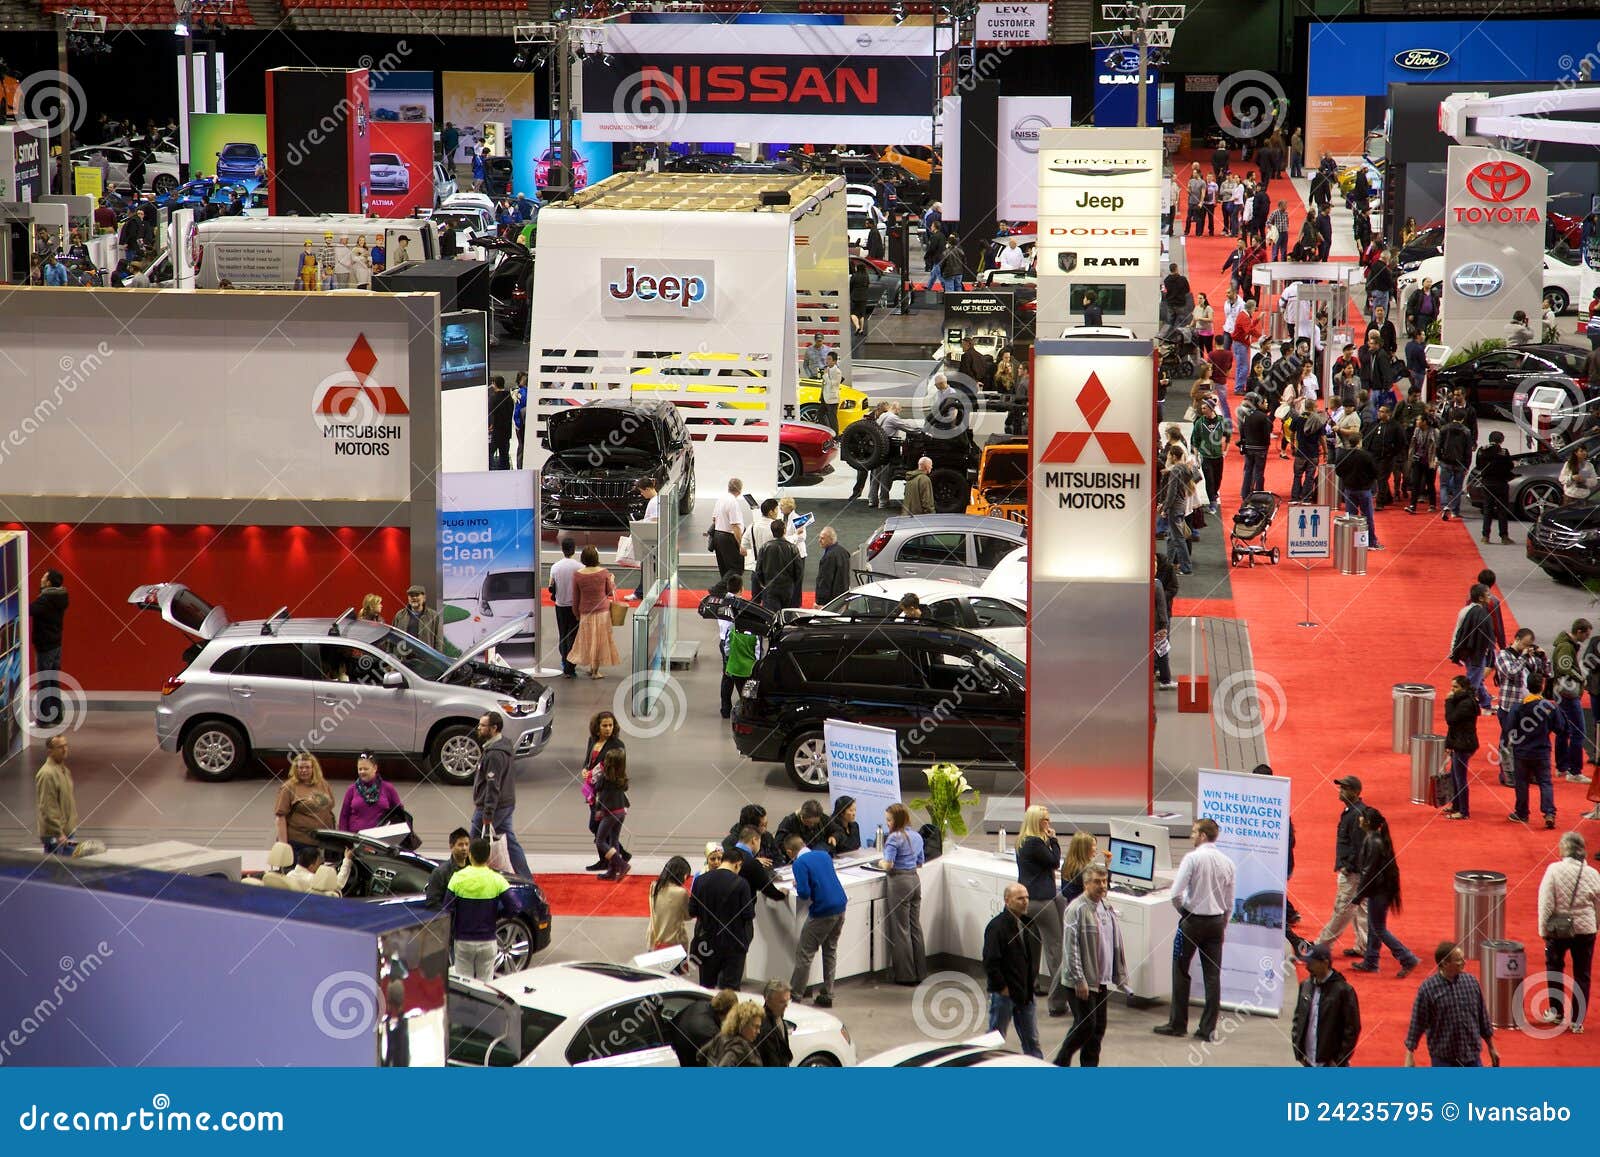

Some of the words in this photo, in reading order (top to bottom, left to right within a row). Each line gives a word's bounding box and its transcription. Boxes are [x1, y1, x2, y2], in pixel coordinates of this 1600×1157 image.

[992, 30, 1031, 38] SERVICE
[1404, 51, 1440, 66] Ford
[641, 66, 878, 104] NISSAN
[1076, 192, 1124, 211] Jeep
[1453, 207, 1541, 223] TOYOTA
[1083, 257, 1140, 267] RAM
[608, 266, 706, 308] Jeep
[323, 424, 401, 440] MITSUBISHI
[335, 442, 390, 456] MOTORS
[1045, 472, 1140, 489] MITSUBISHI
[1058, 493, 1126, 510] MOTORS
[441, 519, 464, 527] PLUG
[467, 518, 489, 527] INTO
[441, 527, 493, 545] Good
[1290, 540, 1328, 548] WASHROOMS
[442, 545, 495, 561] Clean
[442, 563, 476, 577] Fun
[831, 749, 893, 767] VOLKSWAGEN
[831, 761, 873, 773] INOUBLIABLE
[876, 767, 893, 777] POUR
[832, 770, 848, 778] DEUX
[858, 774, 893, 785] ALLEMAGNE
[1203, 790, 1221, 798] WIN
[1224, 792, 1238, 801] THE
[1242, 794, 1281, 806] ULTIMATE
[1203, 800, 1281, 818] VOLKSWAGEN
[1202, 813, 1259, 827] EXPERIENCE
[1262, 820, 1280, 830] FOR
[1235, 827, 1281, 840] GERMANY.
